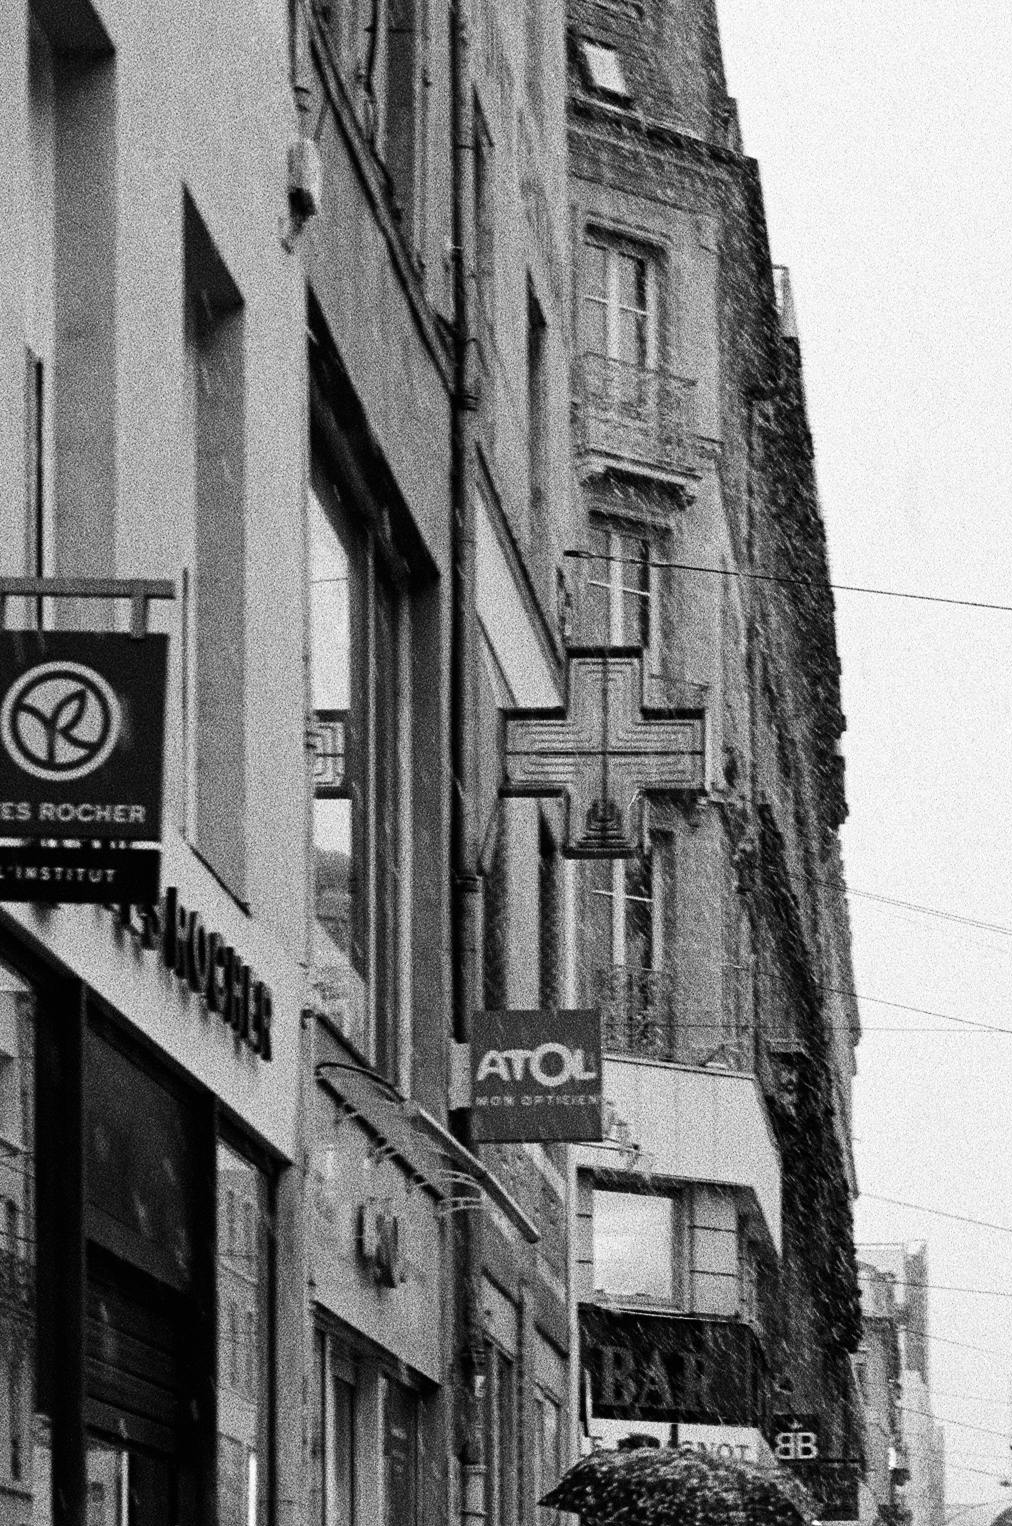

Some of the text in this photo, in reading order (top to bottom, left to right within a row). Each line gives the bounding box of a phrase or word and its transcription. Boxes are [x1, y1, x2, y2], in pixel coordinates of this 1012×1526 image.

[39, 803, 147, 823] ROCHER
[477, 1042, 597, 1087] ATOL
[475, 1094, 600, 1106] MON OPTICIEN
